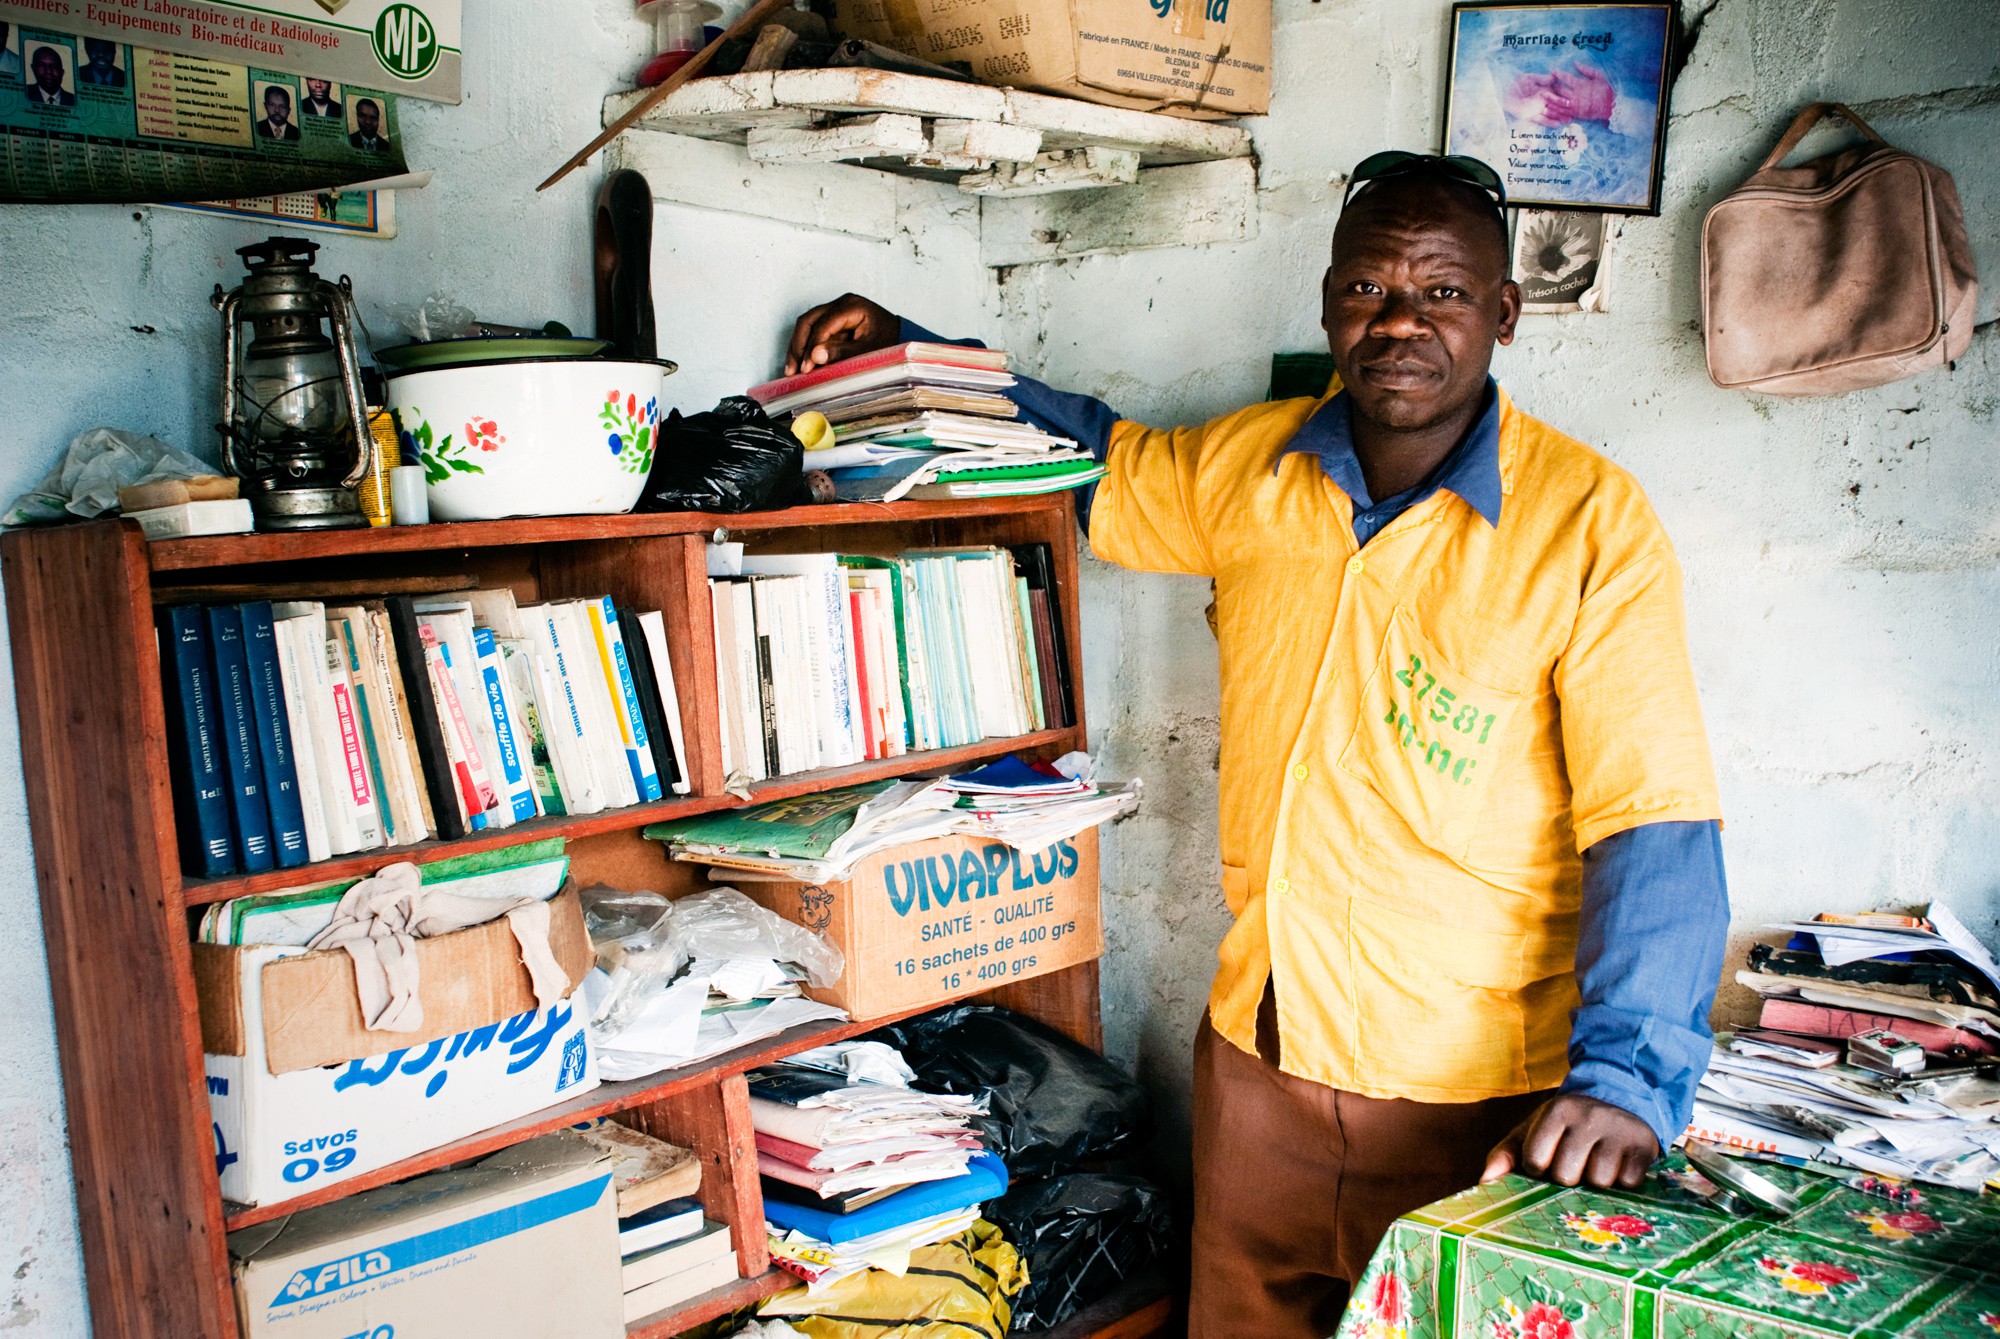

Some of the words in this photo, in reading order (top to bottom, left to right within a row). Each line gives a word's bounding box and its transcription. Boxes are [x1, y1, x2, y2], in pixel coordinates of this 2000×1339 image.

[86, 3, 182, 36] Equipements
[191, 23, 285, 55] Bio-médicaux
[143, 0, 228, 26] Laboratoire
[233, 15, 246, 30] et
[250, 17, 266, 34] de
[271, 20, 340, 49] Radiologie
[383, 7, 431, 72] MP
[1079, 30, 1110, 43] Fabriqué
[1110, 36, 1120, 45] en
[1120, 37, 1150, 50] FRANCE
[1153, 43, 1170, 54] Made
[1170, 46, 1177, 55] in
[1178, 48, 1201, 60] FRANCE
[1502, 34, 1567, 50] Marriage
[1571, 30, 1614, 51] Creed
[1165, 56, 1191, 68] BLEDINA
[1191, 61, 1200, 70] SA
[1172, 68, 1180, 76] BP
[1527, 286, 1558, 299] Trésors
[1560, 276, 1588, 291] cachés
[489, 682, 500, 703] vie
[547, 618, 560, 650] CROIRE
[556, 652, 568, 678] POUR
[563, 681, 584, 738] COMPRENDRE
[622, 675, 634, 698] AVEC
[494, 703, 505, 720] de
[629, 701, 640, 725] PAIX
[1396, 653, 1496, 745] 27581
[341, 716, 354, 735] TOUTE
[635, 726, 646, 742] LA
[346, 743, 357, 752] ET
[498, 722, 516, 767] souffle
[352, 769, 366, 789] TOUTE
[883, 835, 1079, 917] VIVAPLUS
[921, 911, 972, 942] SANTÉ
[994, 892, 1054, 925] QUALITÉ
[895, 958, 916, 976] 16
[921, 943, 989, 971] sachets
[994, 936, 1014, 953] de
[1019, 926, 1047, 945] 400
[1051, 921, 1076, 941] grs
[941, 972, 961, 990] 16
[977, 960, 1007, 980] 400
[1012, 955, 1037, 975] grs
[283, 1128, 358, 1156] SOAPS
[281, 1147, 357, 1183] 60
[314, 1251, 391, 1294] FILA
